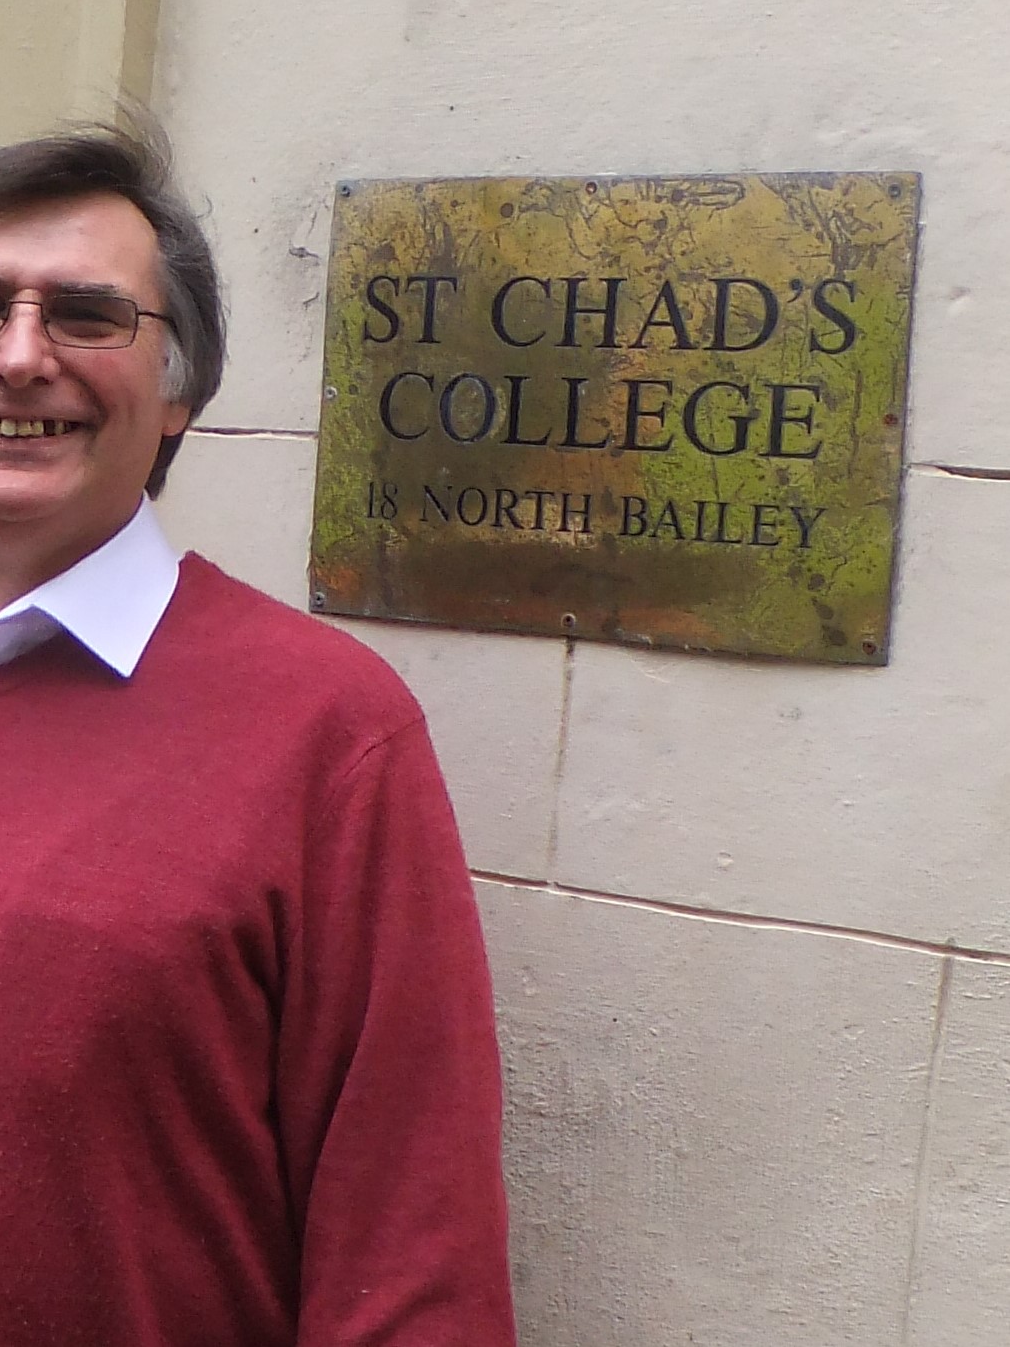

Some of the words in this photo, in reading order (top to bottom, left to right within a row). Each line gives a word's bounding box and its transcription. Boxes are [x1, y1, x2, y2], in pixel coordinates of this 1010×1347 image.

[363, 274, 457, 345] ST
[490, 275, 858, 355] CHAD'S
[378, 371, 824, 460] COLLEGE
[366, 481, 398, 521] 18
[418, 484, 594, 534] NORTH
[618, 495, 829, 549] BAILEY
